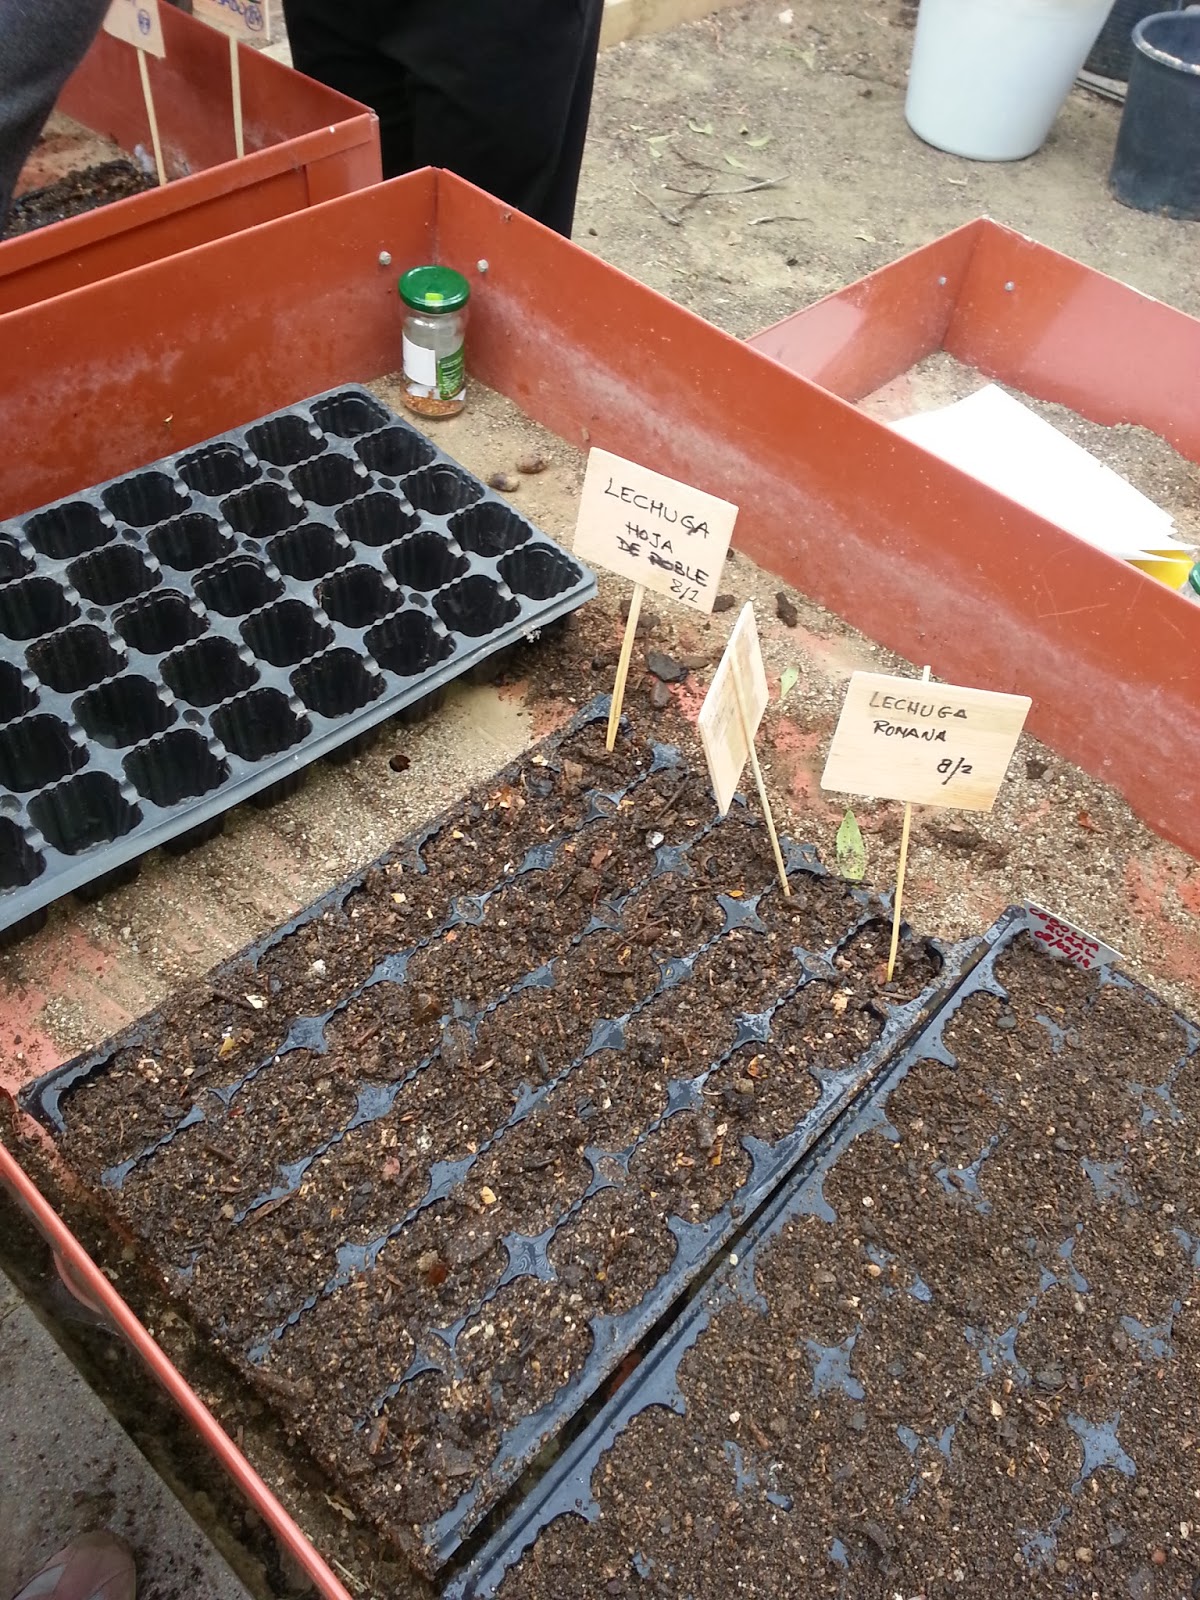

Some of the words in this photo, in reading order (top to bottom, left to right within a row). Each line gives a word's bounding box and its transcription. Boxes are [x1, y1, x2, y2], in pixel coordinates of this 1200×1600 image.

[604, 477, 710, 539] LECHUGA
[625, 521, 673, 554] HOJA
[616, 535, 641, 557] DE
[648, 551, 709, 587] ROBLE
[869, 691, 968, 719] LECHUGA
[873, 719, 947, 742] ROMANA
[936, 757, 973, 785] 8/2
